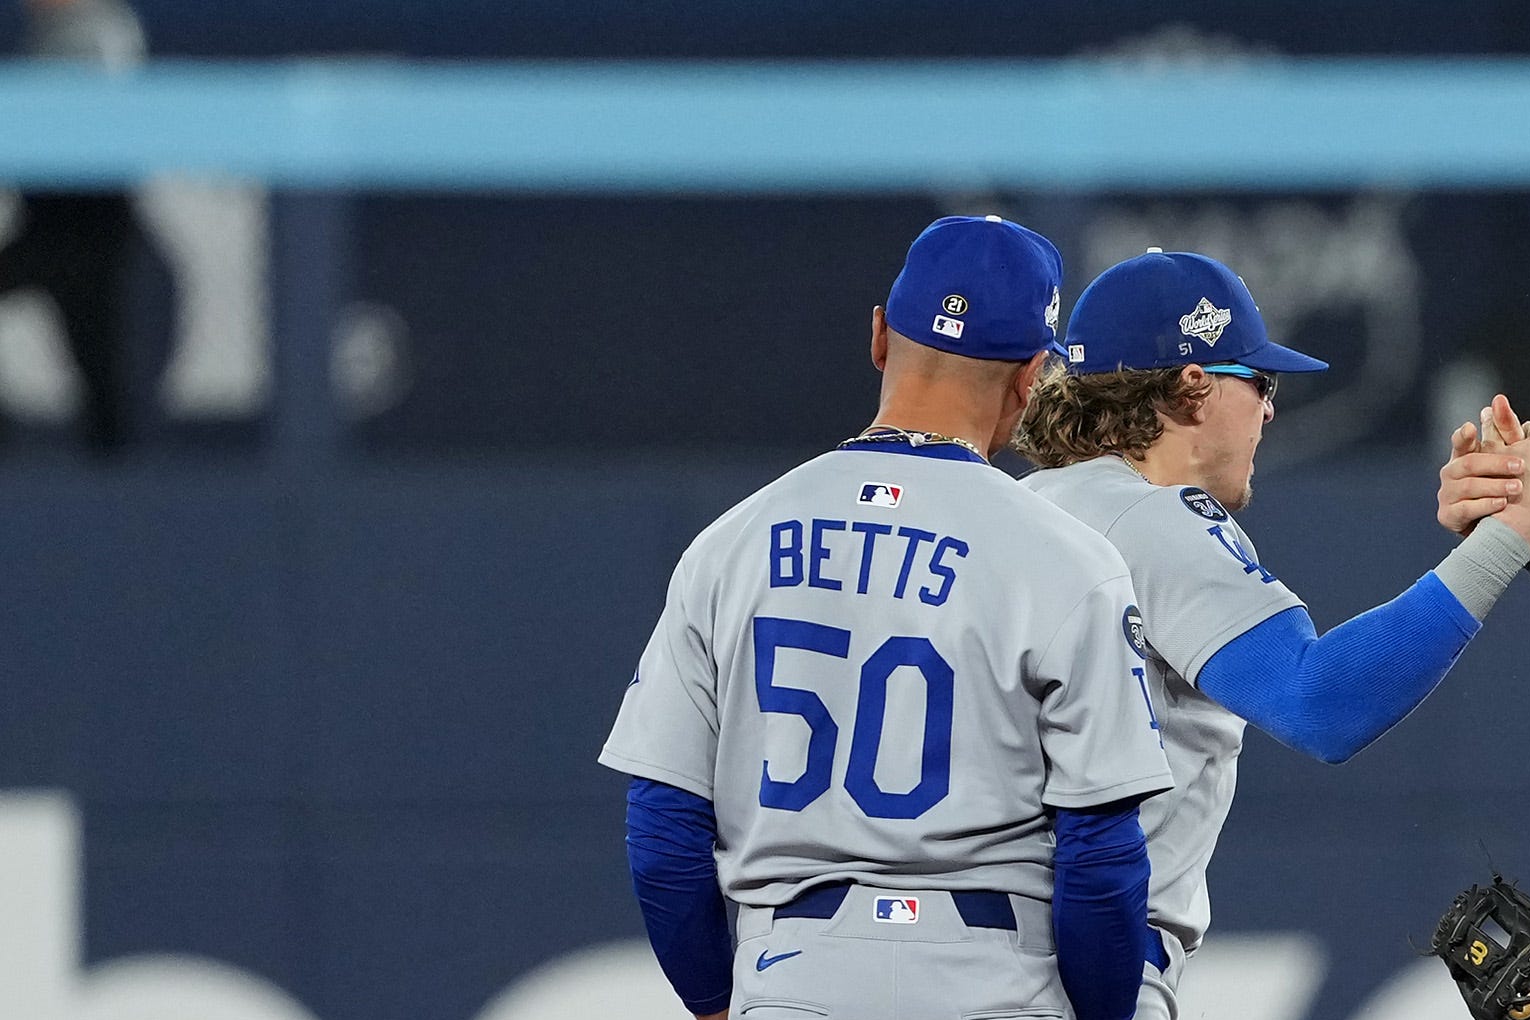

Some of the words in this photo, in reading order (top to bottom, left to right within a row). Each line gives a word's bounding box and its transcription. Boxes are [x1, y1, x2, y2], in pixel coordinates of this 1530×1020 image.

[947, 297, 963, 313] 21
[1178, 342, 1193, 356] 51
[769, 518, 970, 607] BETTS
[752, 616, 956, 820] 50
